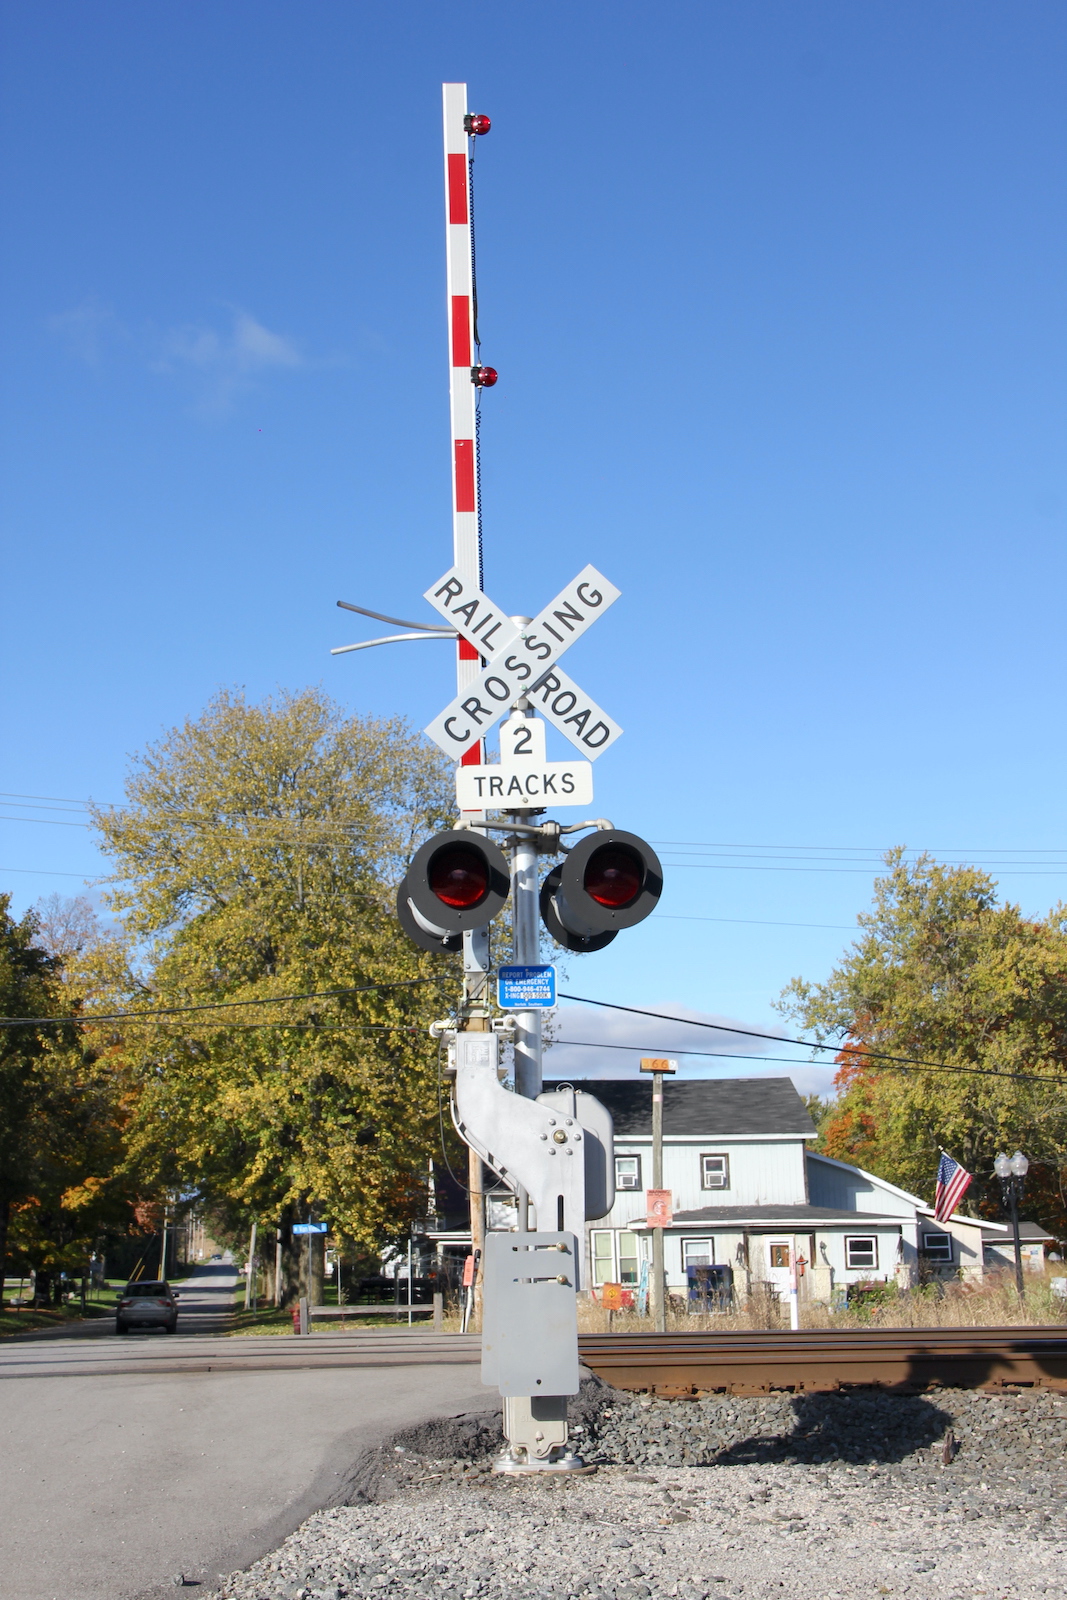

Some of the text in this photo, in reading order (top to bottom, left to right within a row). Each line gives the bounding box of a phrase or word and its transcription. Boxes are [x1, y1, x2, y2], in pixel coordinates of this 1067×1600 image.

[434, 577, 609, 748] RAIL ROAD
[444, 582, 602, 742] CROSSING
[474, 773, 575, 796] TRACKS
[513, 727, 533, 754] 2
